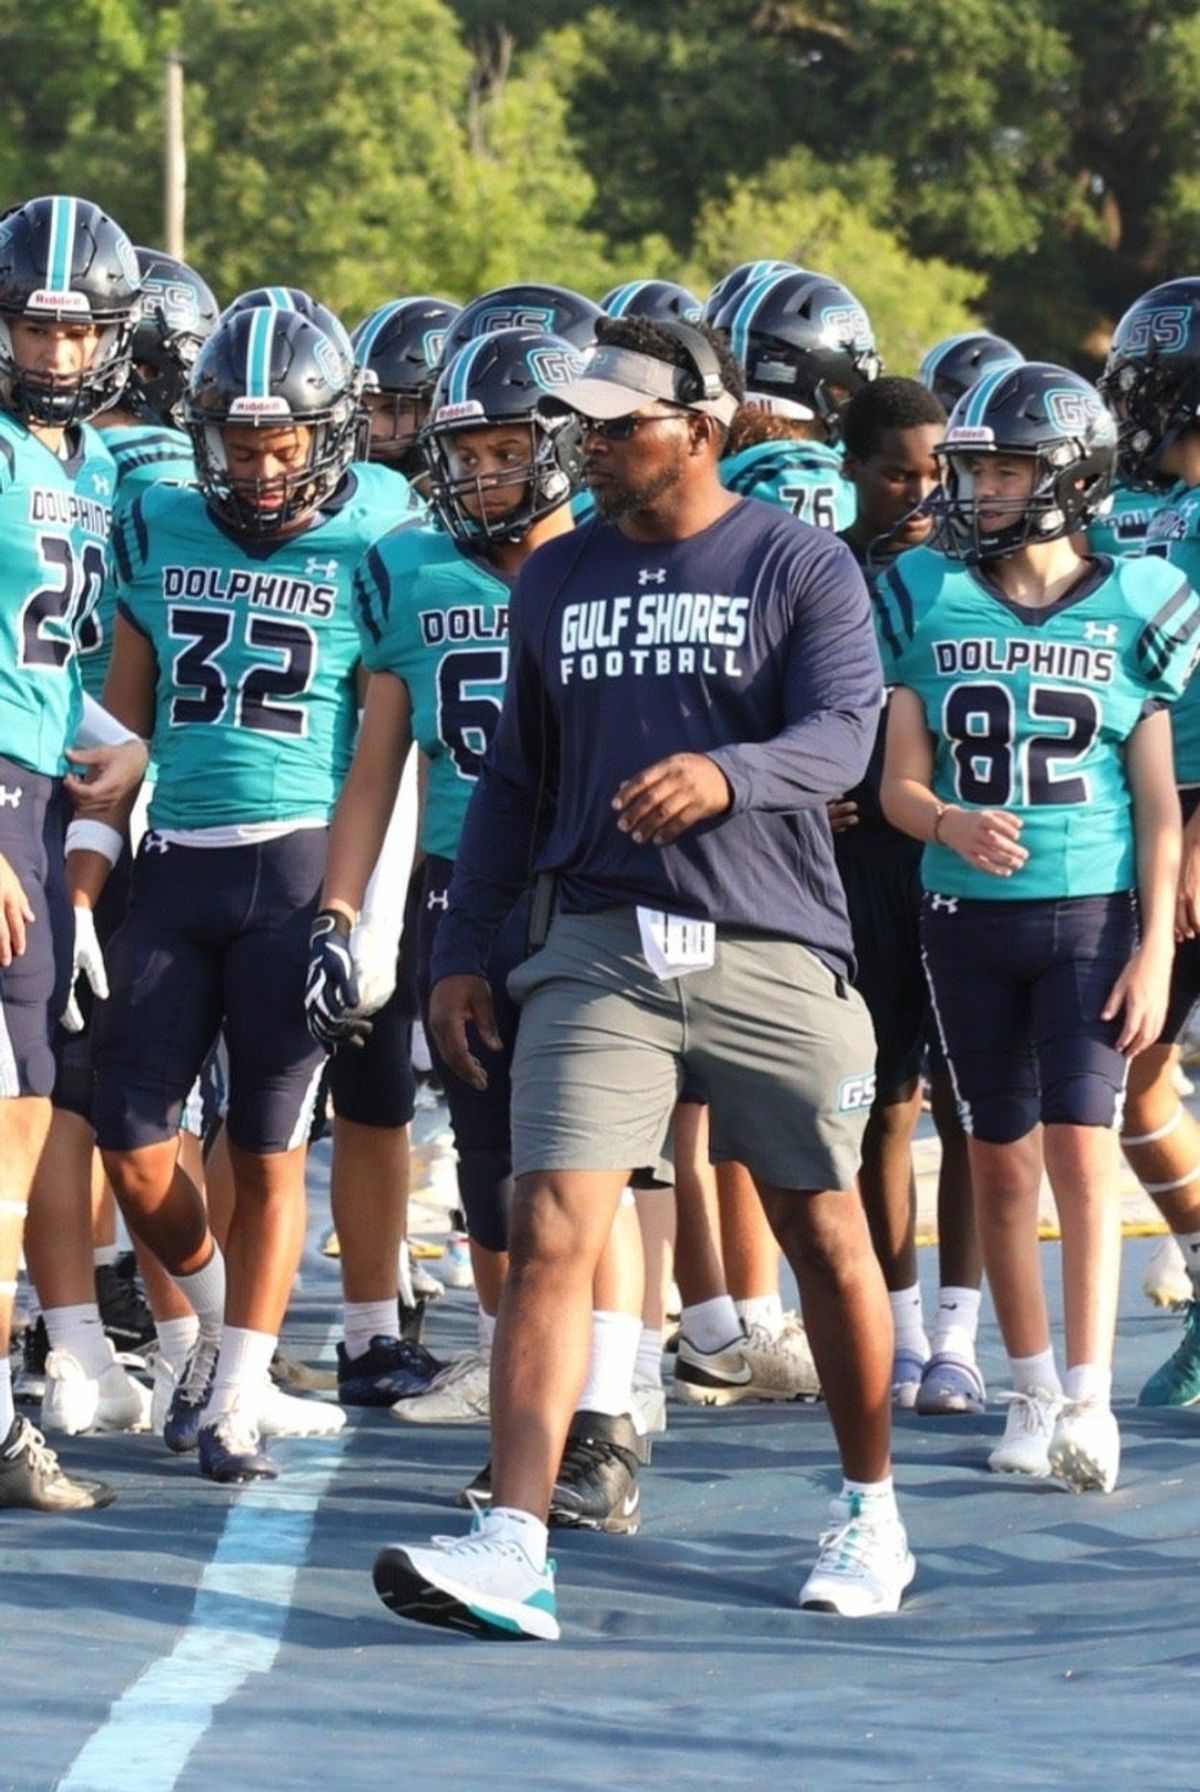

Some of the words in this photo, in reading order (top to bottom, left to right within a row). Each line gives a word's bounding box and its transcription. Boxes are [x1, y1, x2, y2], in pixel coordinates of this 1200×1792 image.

[1122, 307, 1190, 356] GS
[31, 485, 113, 539] DOLPHINS
[779, 485, 837, 532] 76
[163, 566, 338, 618] DOLPHINS
[561, 597, 631, 654] GULF
[636, 593, 750, 647] SHORES
[167, 604, 317, 738] 32
[560, 648, 743, 685] FOOTBALL
[932, 638, 1116, 683] DOLPHINS
[942, 680, 1101, 807] 82
